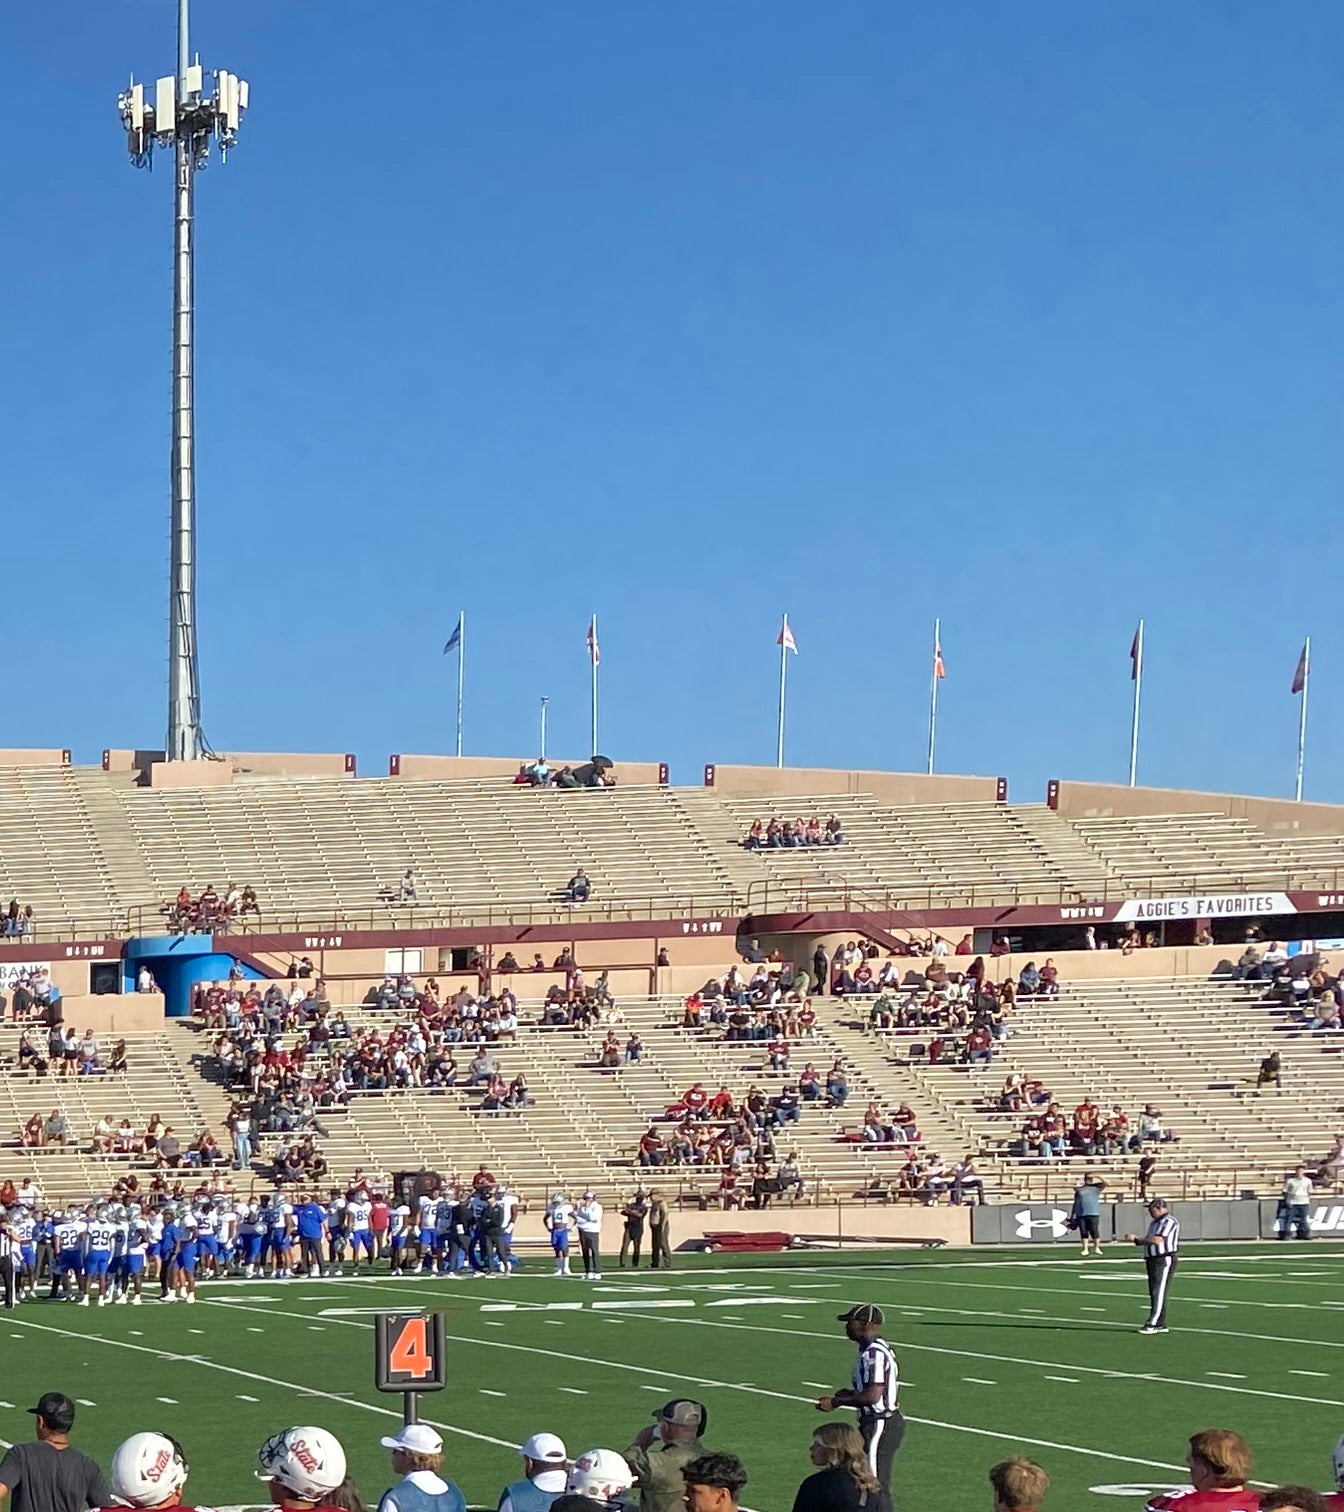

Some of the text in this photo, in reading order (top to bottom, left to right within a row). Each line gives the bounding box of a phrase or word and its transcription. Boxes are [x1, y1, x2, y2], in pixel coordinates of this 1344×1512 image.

[1136, 896, 1273, 917] AGGIE'S FAVORITES
[61, 1230, 79, 1246] 22
[91, 1229, 111, 1246] 29
[389, 1317, 433, 1379] 4
[146, 1449, 171, 1483] State
[289, 1438, 320, 1475] State
